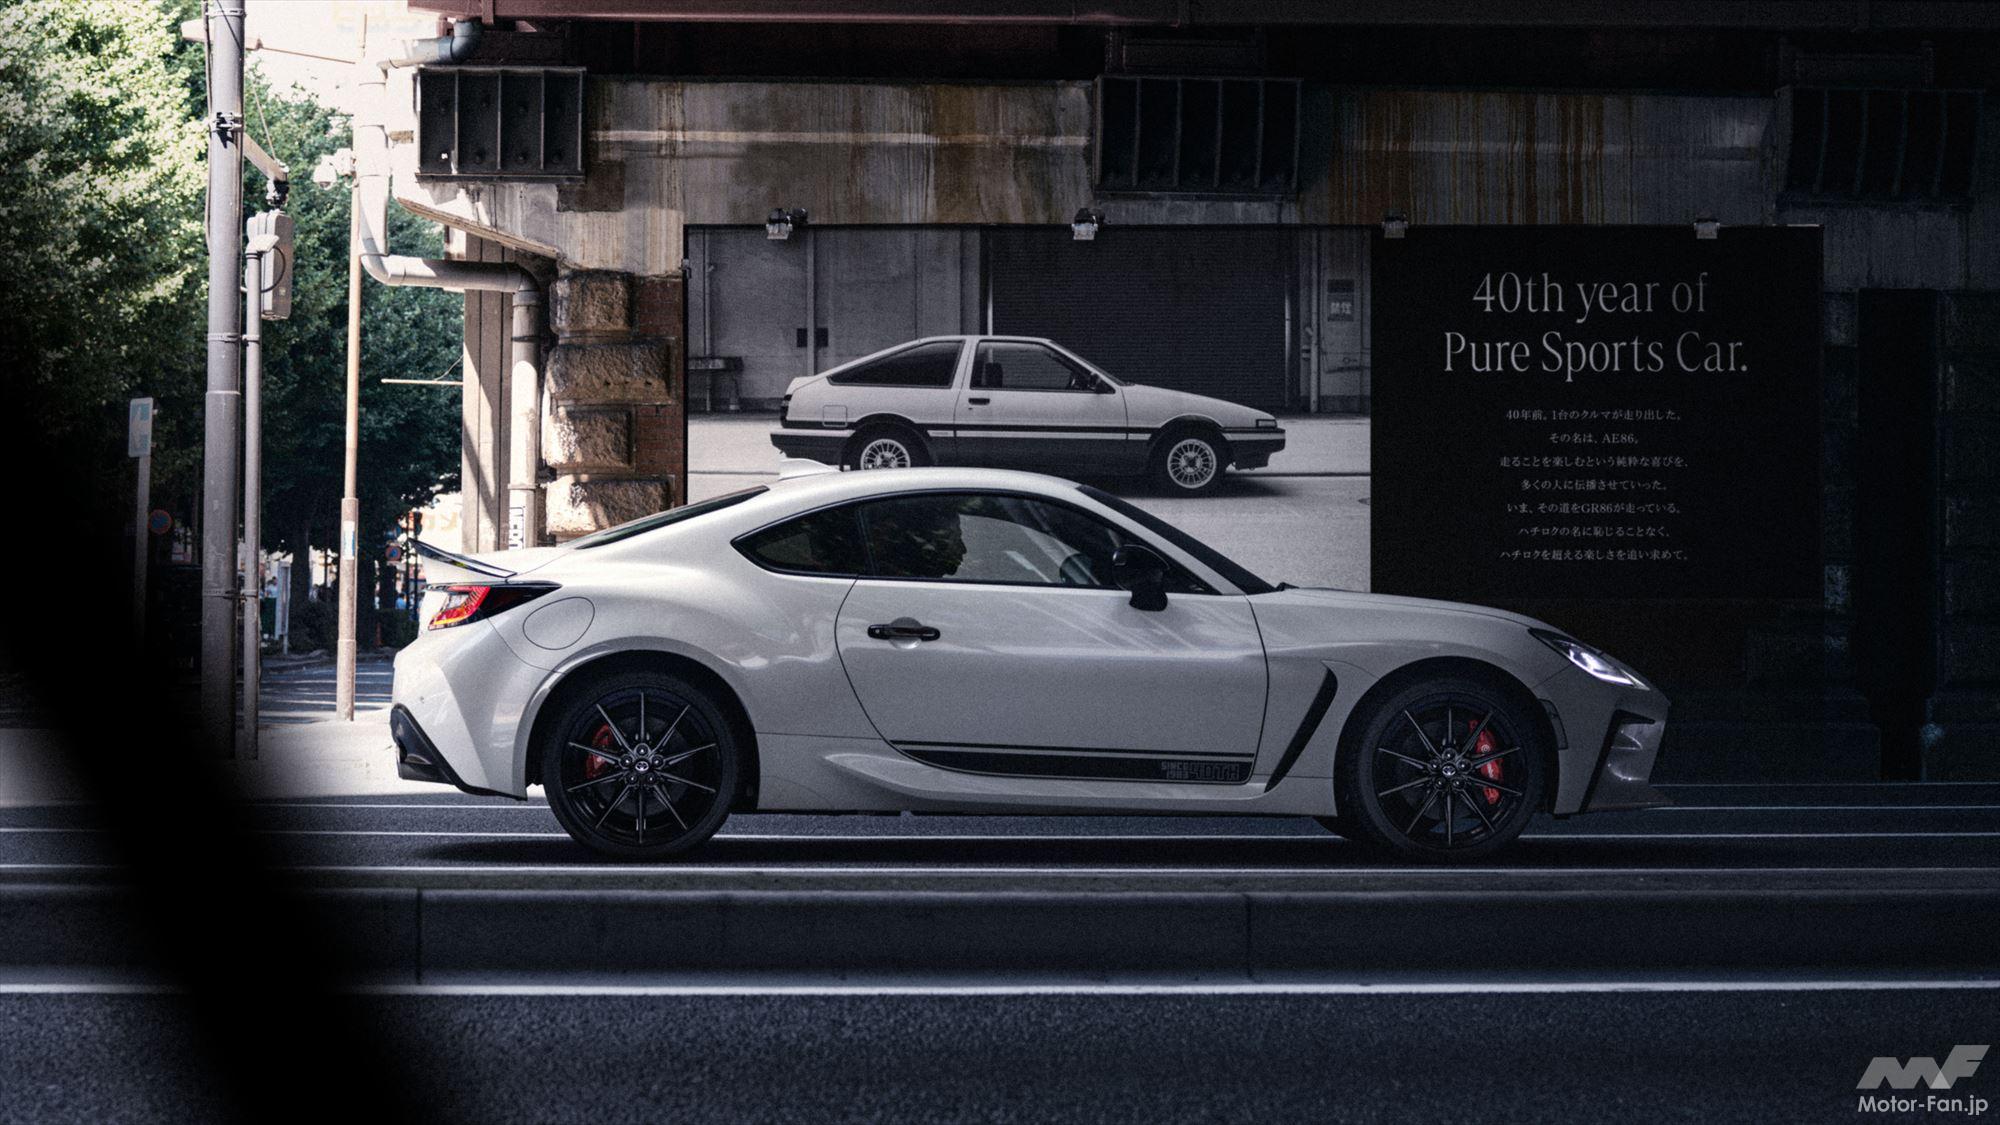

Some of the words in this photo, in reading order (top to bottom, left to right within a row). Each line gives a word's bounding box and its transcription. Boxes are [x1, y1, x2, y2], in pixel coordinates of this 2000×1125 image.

[1472, 271, 1565, 313] 40th
[1575, 281, 1660, 324] year
[1671, 271, 1708, 313] of
[1444, 331, 1531, 372] Pure
[1541, 330, 1665, 382] Sports
[1676, 331, 1749, 372] Car.
